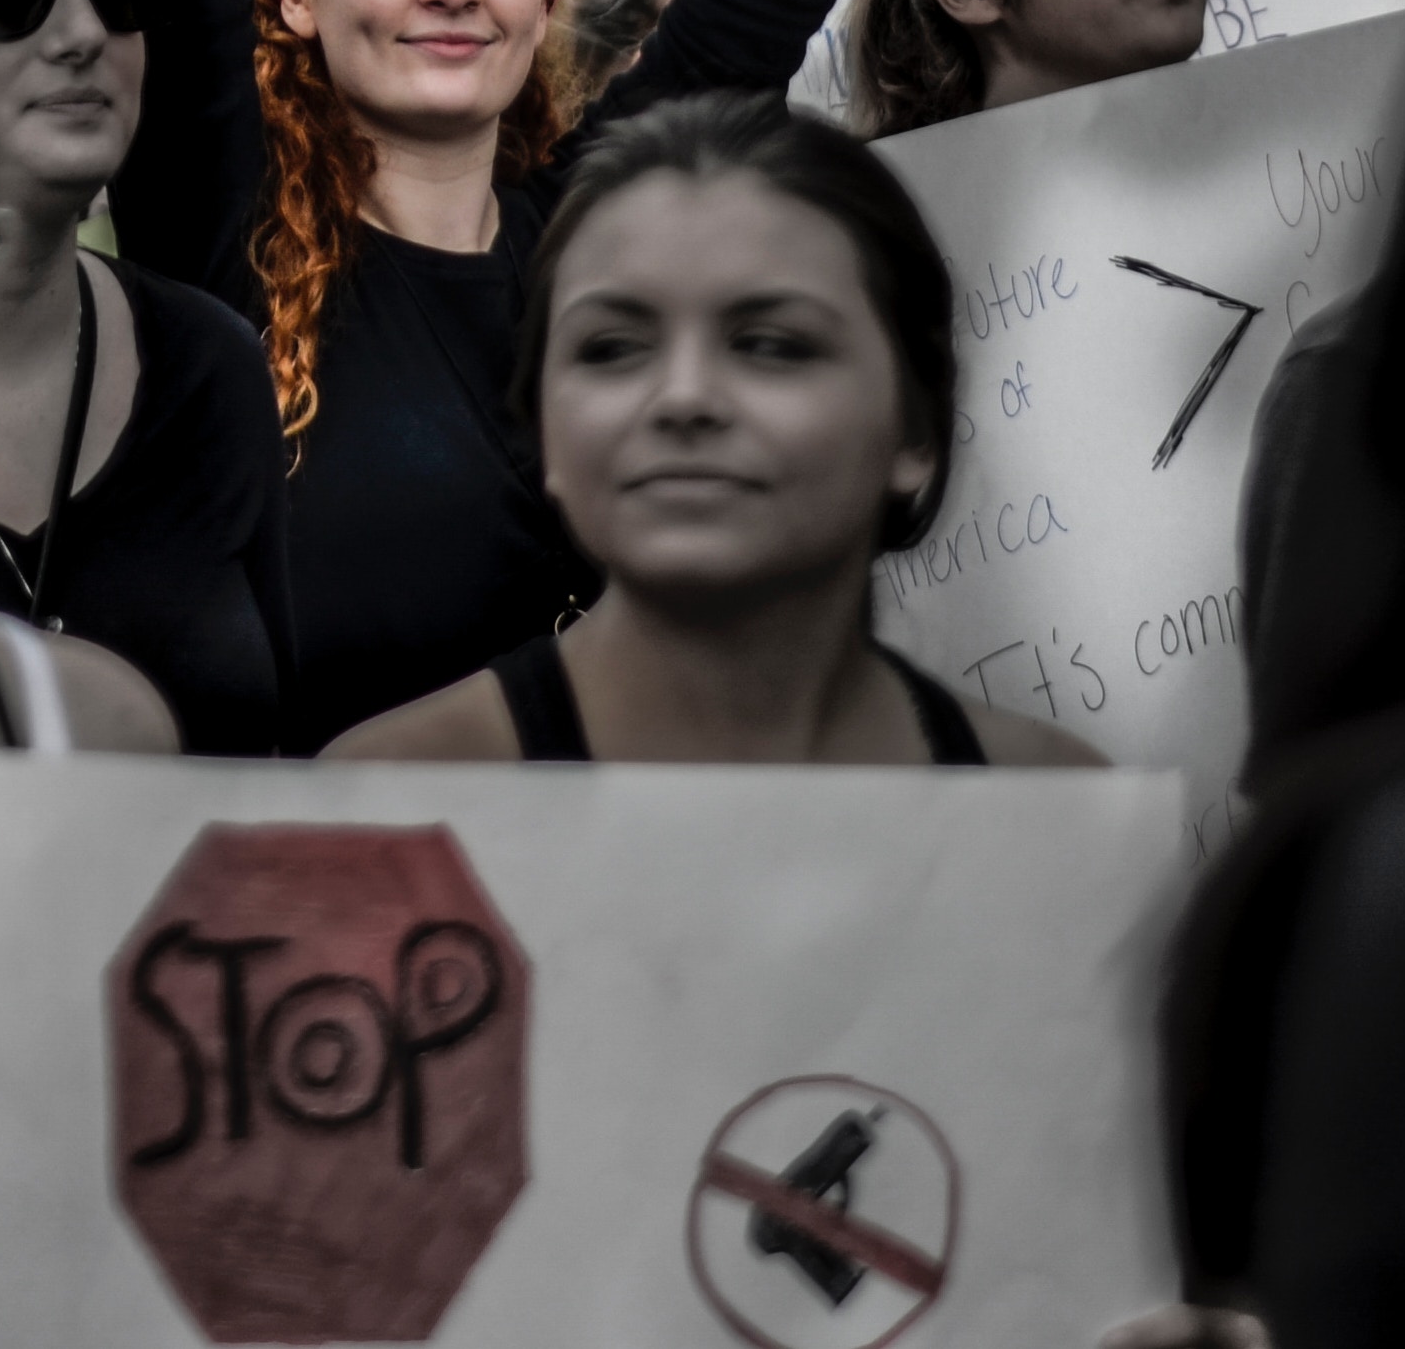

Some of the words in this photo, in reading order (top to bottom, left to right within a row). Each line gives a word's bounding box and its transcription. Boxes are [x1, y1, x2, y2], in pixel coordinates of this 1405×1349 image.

[949, 254, 1079, 347] uture
[1000, 360, 1032, 418] of
[130, 918, 505, 1171] STOP
